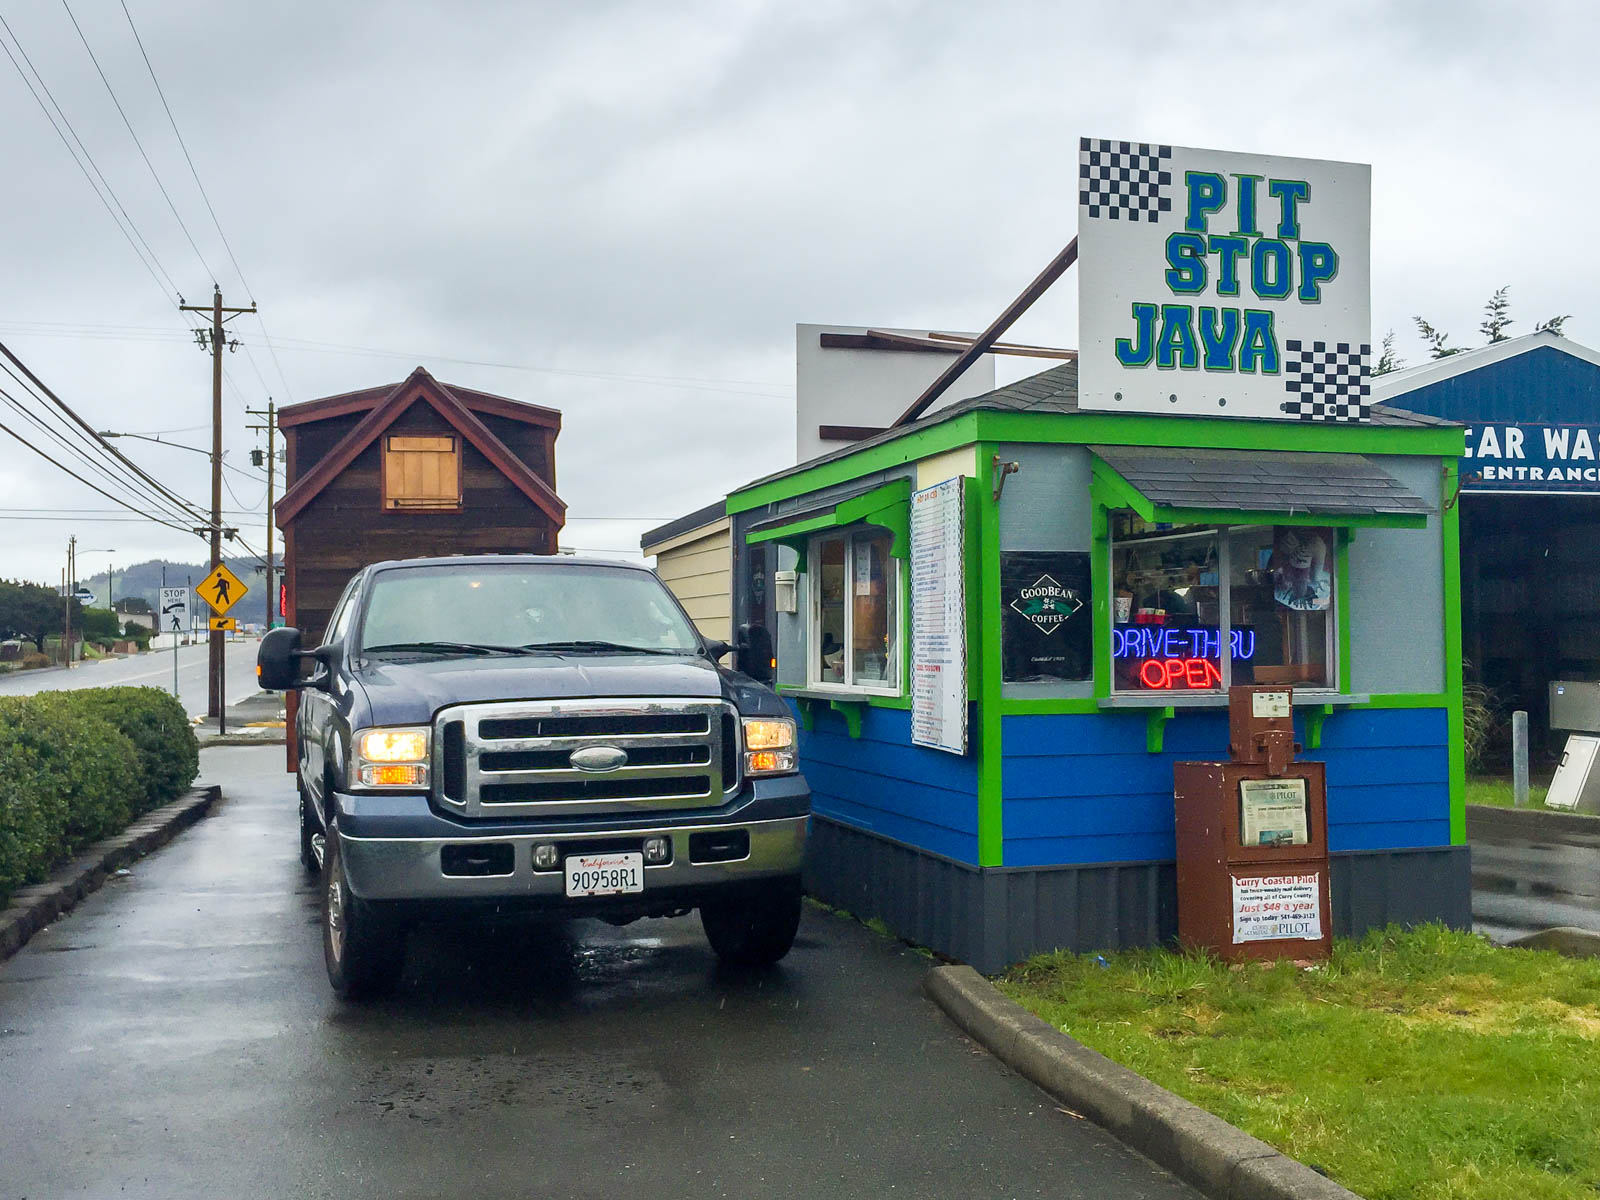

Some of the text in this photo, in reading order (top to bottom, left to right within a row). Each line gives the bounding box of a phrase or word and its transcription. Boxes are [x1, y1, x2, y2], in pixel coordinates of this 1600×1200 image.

[1185, 170, 1311, 240] PIT
[1165, 231, 1340, 303] STOP
[1115, 302, 1281, 375] JAVA
[1543, 428, 1600, 460] WA
[1483, 466, 1600, 481] ENTRANC
[164, 589, 185, 598] STOP
[1031, 614, 1064, 623] COFFEE
[1112, 628, 1255, 659] DRIVE-THRU
[1140, 659, 1222, 688] OPEN
[1276, 791, 1297, 800] PILOT
[582, 858, 626, 869] California
[572, 868, 638, 891] 90958R1
[1235, 875, 1317, 888] Curry Coastal Pilot
[1278, 893, 1292, 901] Curry
[1239, 904, 1260, 913] Just
[1263, 902, 1280, 912] $48
[1292, 903, 1315, 913] year
[1279, 922, 1310, 934] PILOT
